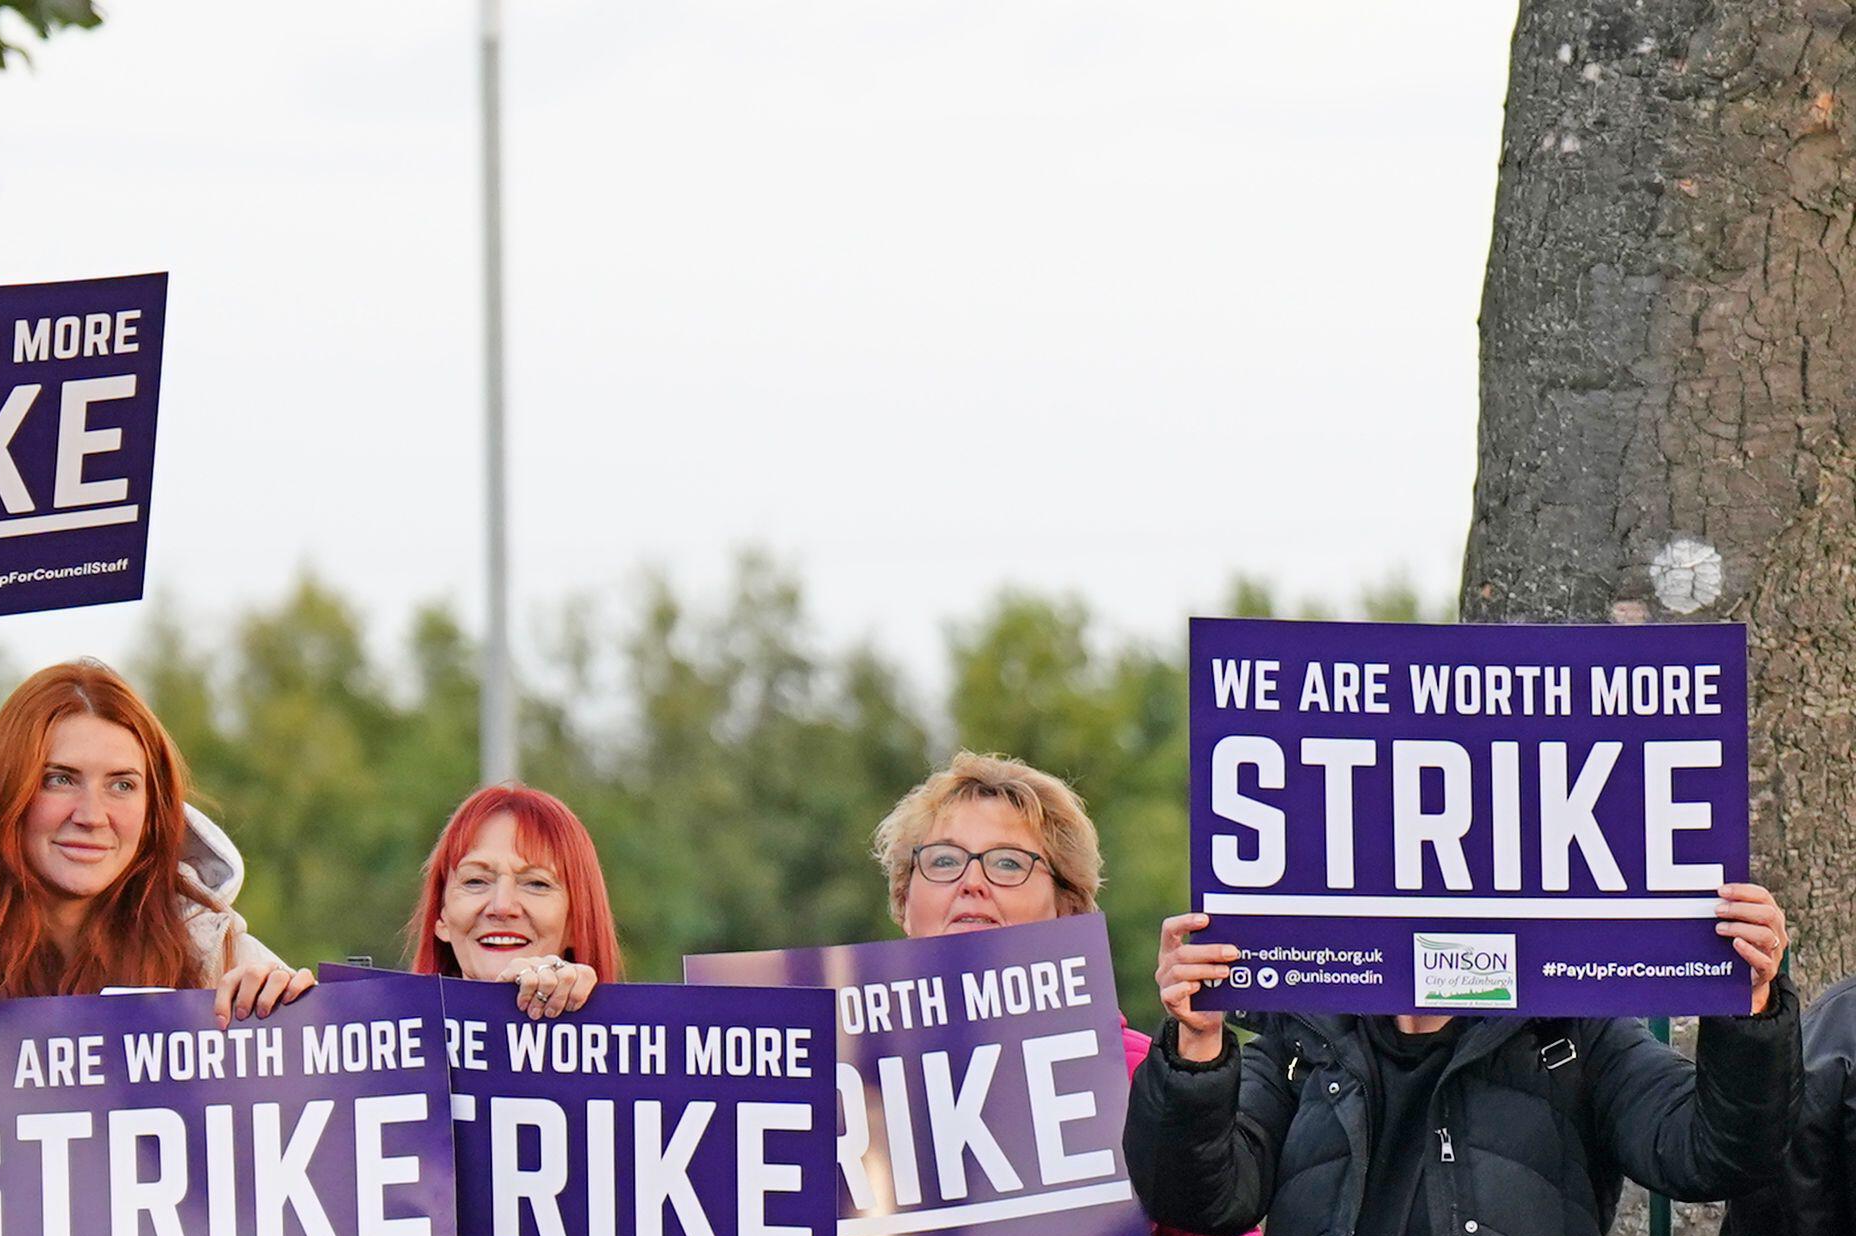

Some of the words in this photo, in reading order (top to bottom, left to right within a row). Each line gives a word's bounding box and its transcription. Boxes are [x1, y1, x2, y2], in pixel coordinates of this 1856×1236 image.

[13, 309, 141, 363] MORE
[1211, 658, 1280, 711] WE
[1298, 661, 1390, 714] ARE
[1409, 664, 1571, 716] WORTH
[1590, 664, 1722, 716] MORE
[1210, 735, 1724, 892] STRIKE
[1284, 969, 1383, 986] @unisonedin
[1424, 952, 1507, 970] UNISON
[1425, 976, 1445, 987] City
[1449, 976, 1459, 987] of
[1461, 976, 1513, 988] Edinburgh
[1542, 961, 1733, 980] #PayUpForCouncilStaff
[839, 976, 948, 1035] ORTH
[961, 956, 1091, 1022] MORE
[14, 1035, 105, 1089] ARE
[123, 1027, 283, 1084] WORTH
[302, 1017, 426, 1075] MORE
[444, 1018, 488, 1070] RE
[506, 1023, 666, 1075] WORTH
[686, 1025, 813, 1079] MORE
